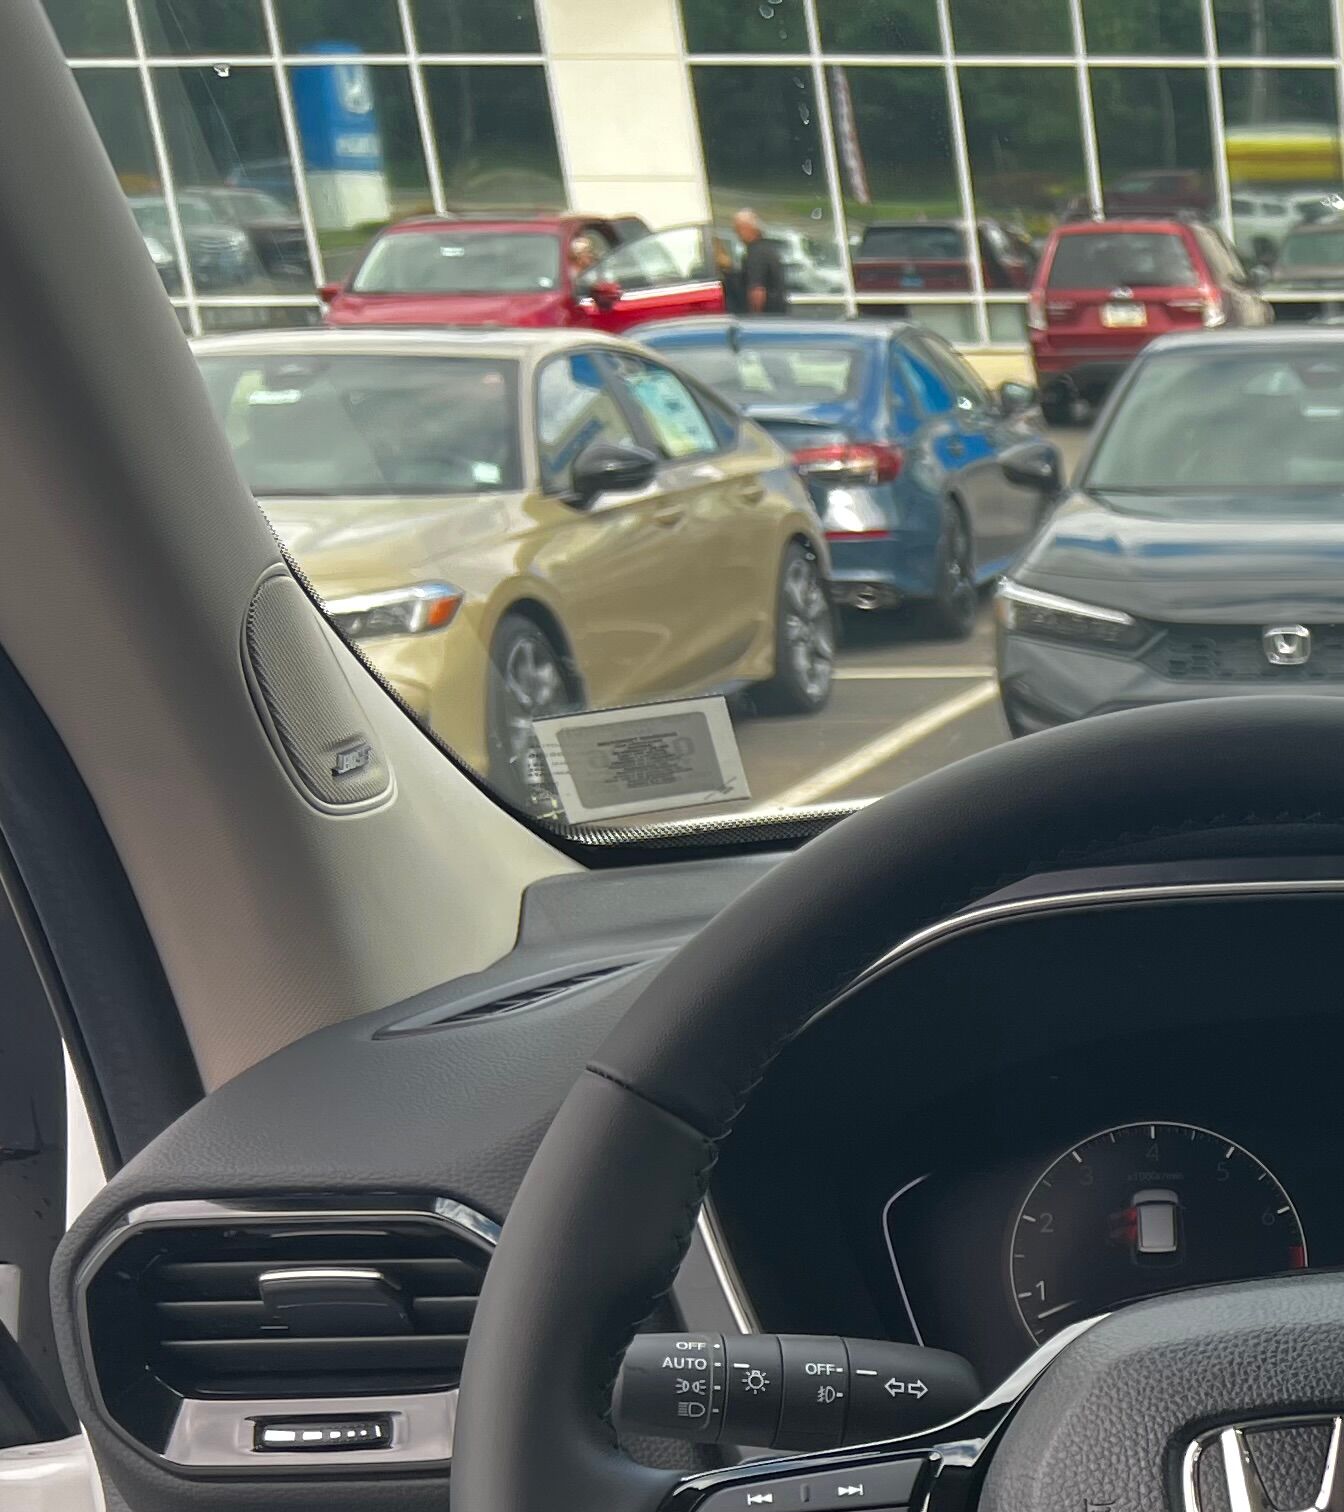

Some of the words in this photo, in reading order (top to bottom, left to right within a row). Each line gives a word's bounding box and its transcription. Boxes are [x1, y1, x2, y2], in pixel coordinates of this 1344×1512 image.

[1040, 1213, 1054, 1233] 2
[1035, 1280, 1046, 1301] 1
[676, 1341, 707, 1351] OFF
[662, 1357, 708, 1370] AUTO
[805, 1363, 836, 1376] OFF
